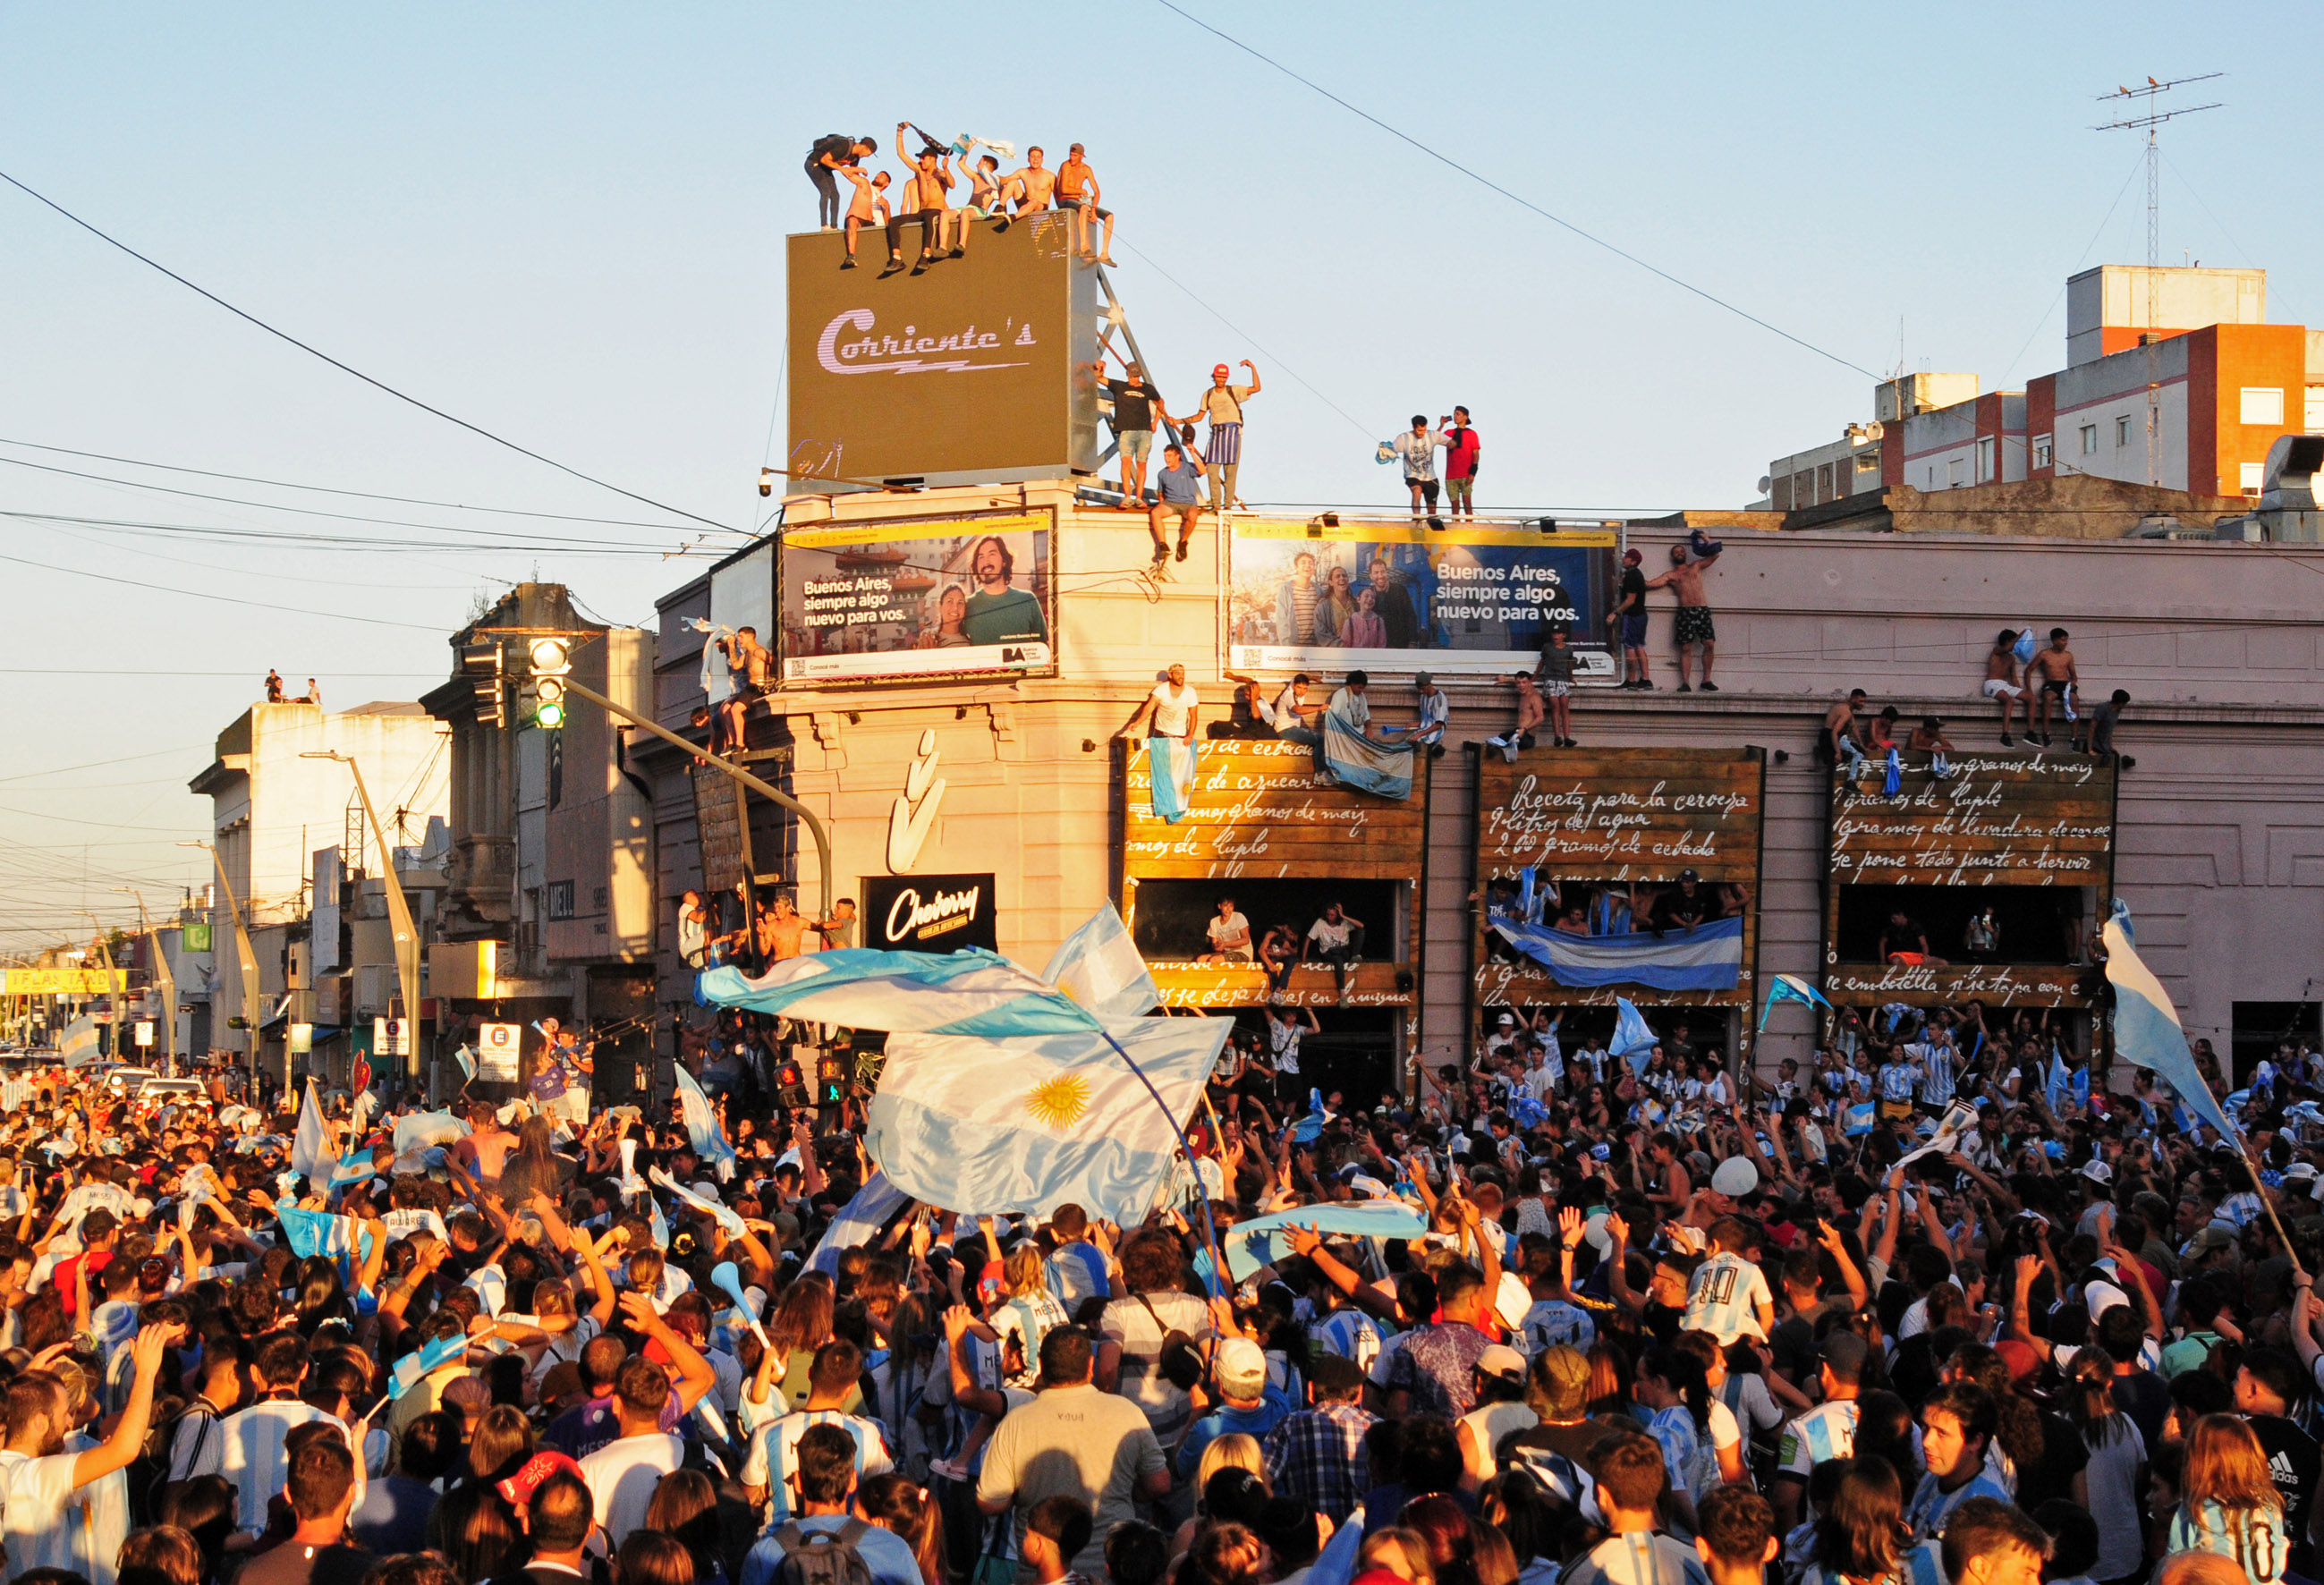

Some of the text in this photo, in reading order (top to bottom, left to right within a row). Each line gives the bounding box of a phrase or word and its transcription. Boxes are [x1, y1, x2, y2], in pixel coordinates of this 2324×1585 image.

[1437, 564, 1561, 585] Buenos Aires,
[804, 576, 893, 595] Buenos Aires,
[1436, 582, 1556, 604] siempre algo
[803, 592, 888, 611] siempre algo
[804, 608, 906, 626] nuevo para vos.
[1437, 605, 1581, 623] nuevo para vos.
[1003, 647, 1025, 663] BA
[1511, 774, 1588, 810] Receta
[2017, 856, 2031, 869] a
[918, 925, 940, 939] CERVEZA
[495, 1030, 505, 1043] E
[1699, 1266, 1739, 1306] 10
